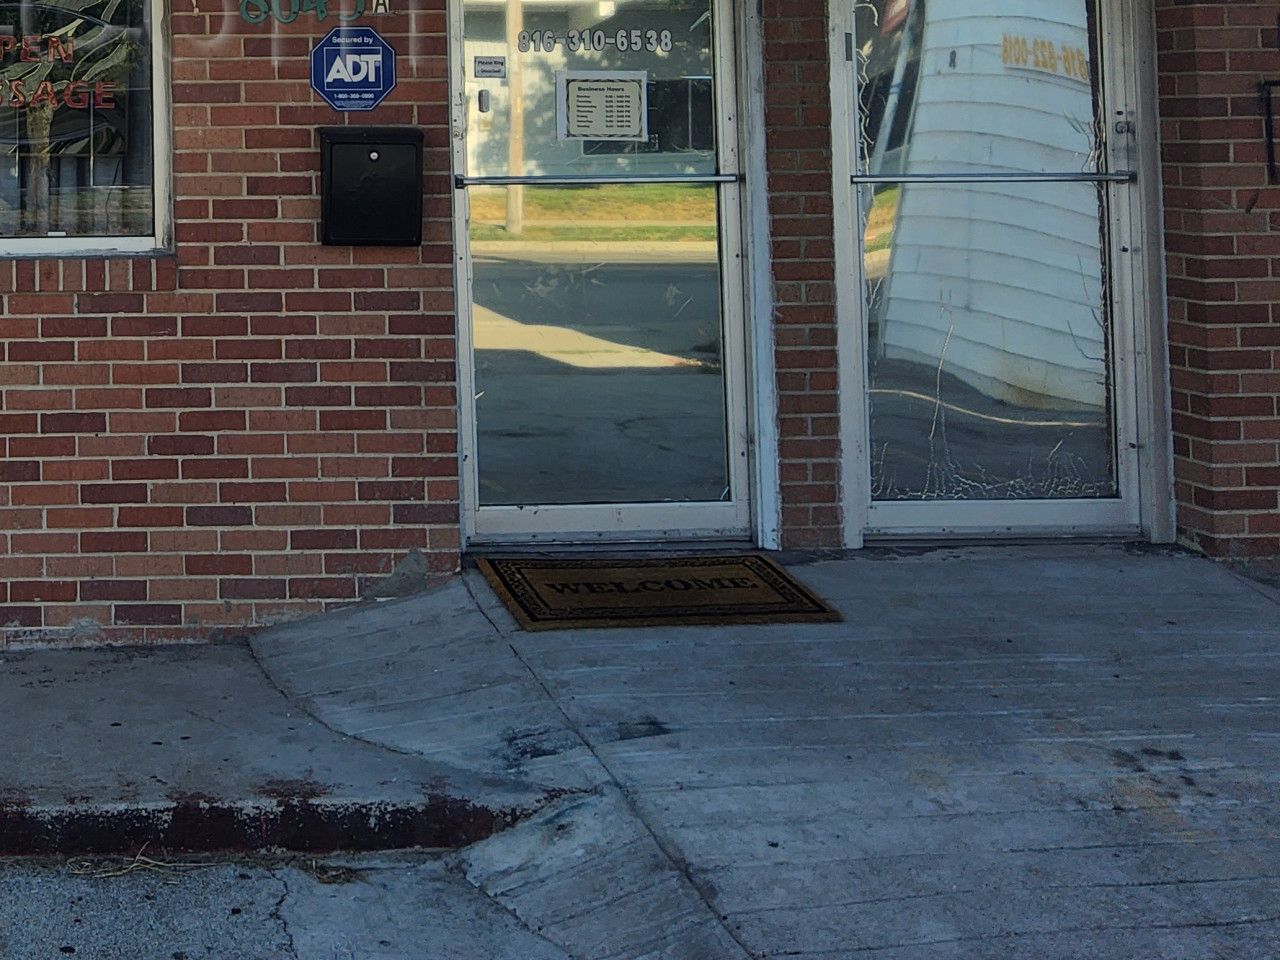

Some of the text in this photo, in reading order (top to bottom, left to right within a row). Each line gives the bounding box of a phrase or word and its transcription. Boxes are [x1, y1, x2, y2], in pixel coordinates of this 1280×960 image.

[331, 36, 373, 45] Secured by
[517, 29, 673, 53] 816-310-6538
[325, 54, 382, 83] ADT
[547, 576, 760, 597] WELCOME
